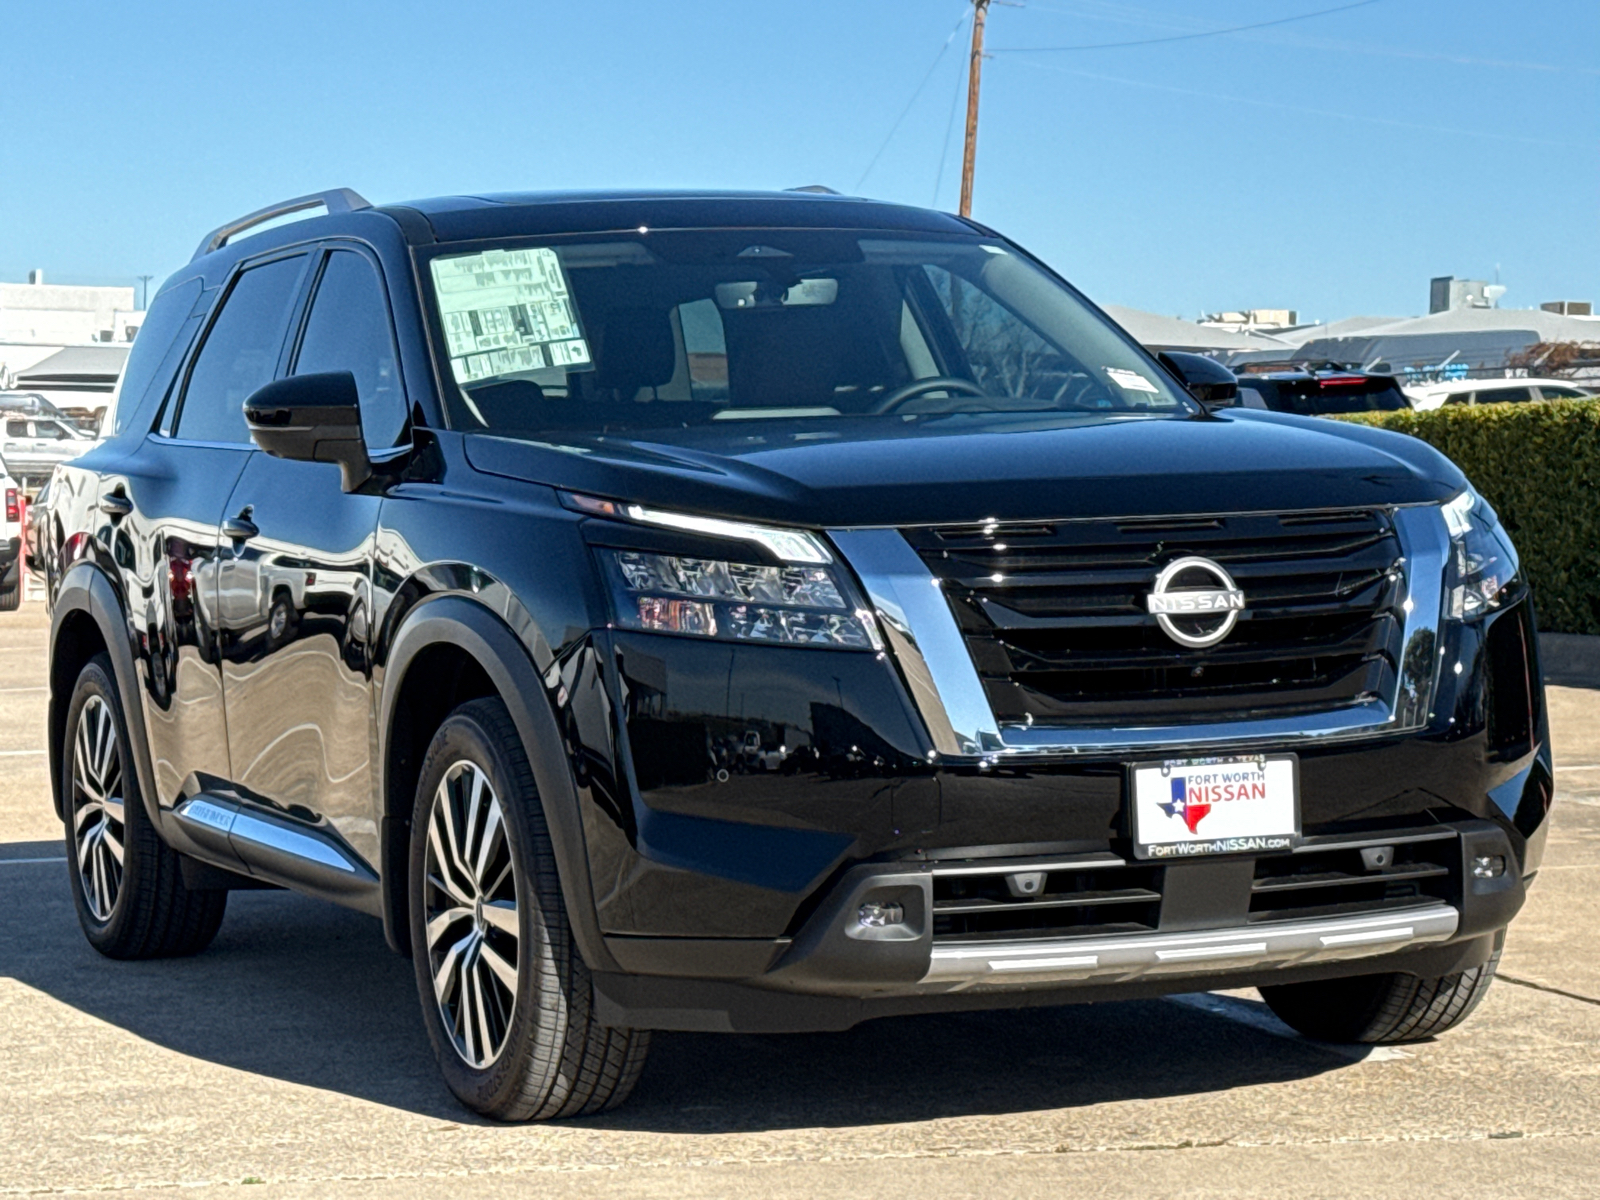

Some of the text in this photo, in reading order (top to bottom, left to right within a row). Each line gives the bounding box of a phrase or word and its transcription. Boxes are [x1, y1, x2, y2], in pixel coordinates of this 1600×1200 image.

[1152, 594, 1244, 611] NISSAN
[1163, 753, 1266, 767] FORT WORTH TEXAS
[1188, 771, 1265, 785] FORT WORTH
[1188, 783, 1266, 803] NISSAN
